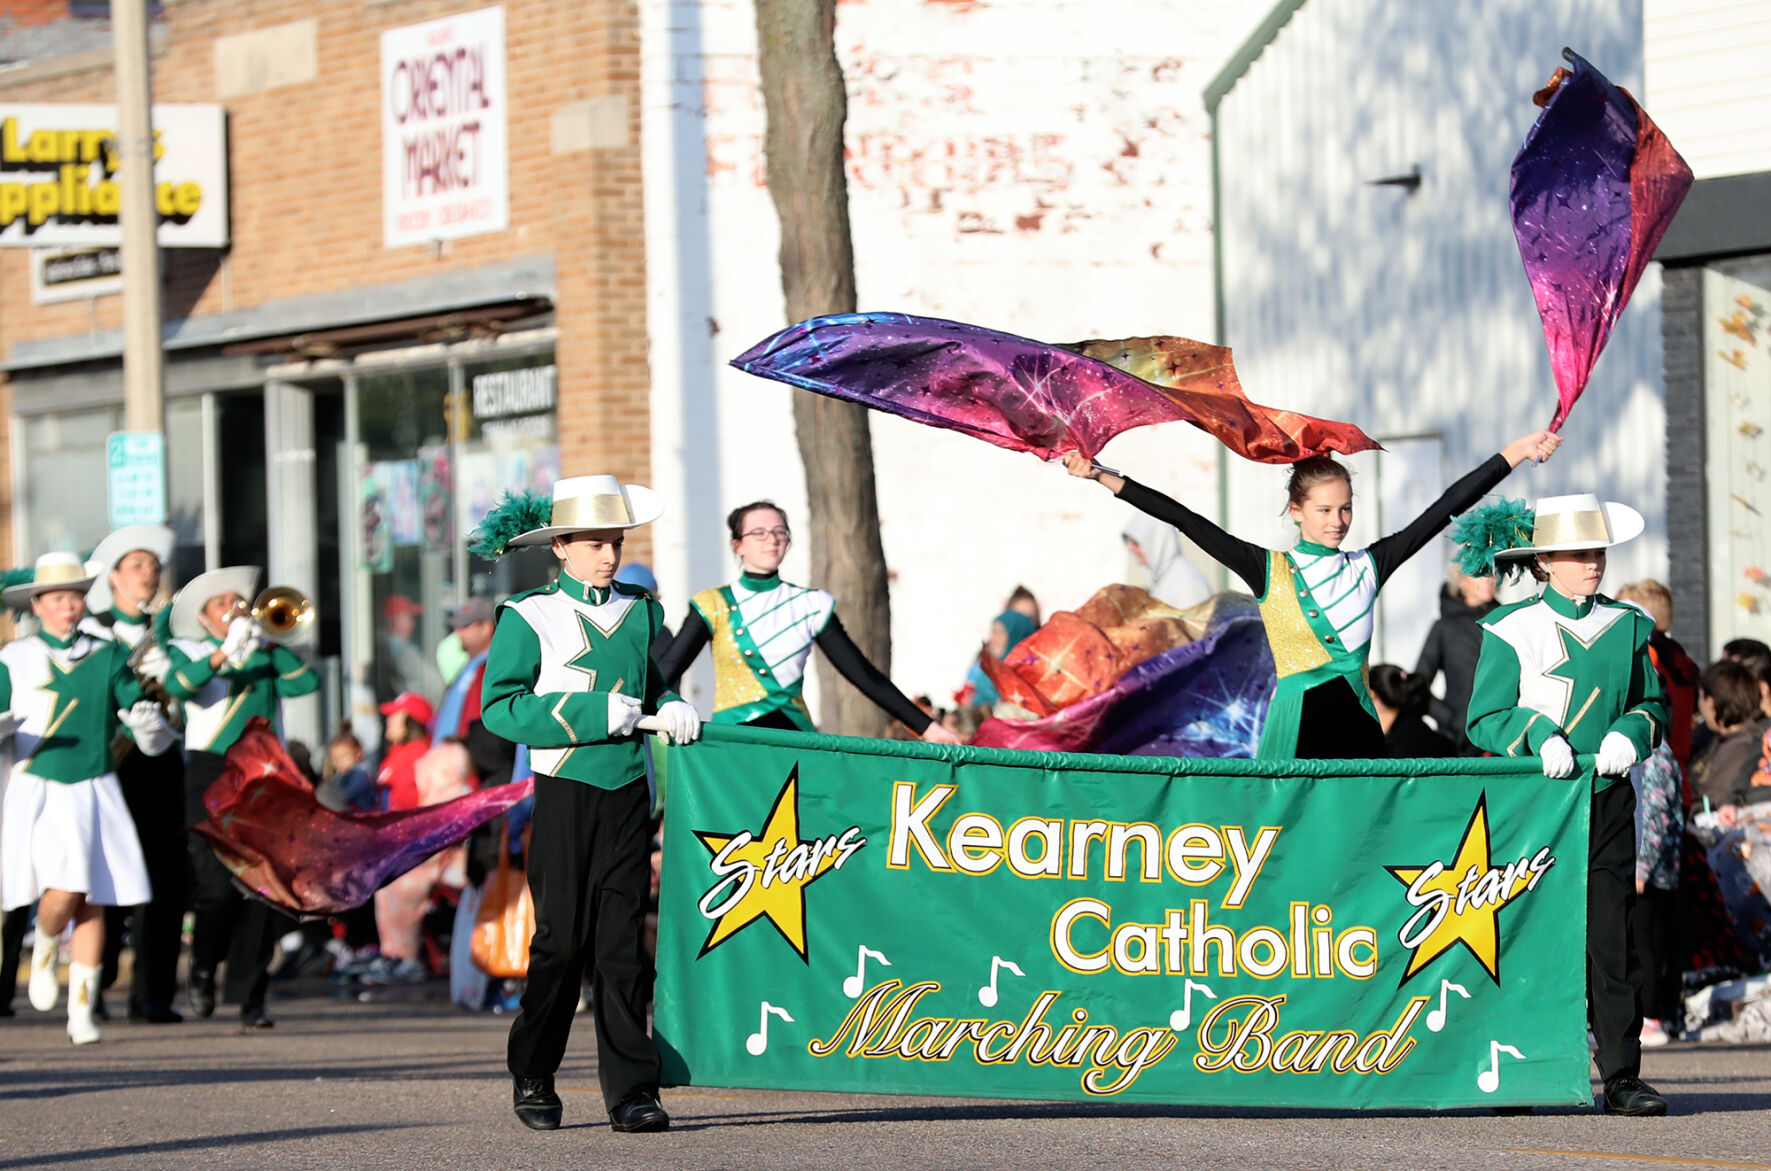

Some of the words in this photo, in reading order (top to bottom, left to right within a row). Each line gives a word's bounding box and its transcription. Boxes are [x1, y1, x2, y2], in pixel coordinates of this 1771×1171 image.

[391, 45, 489, 124] ORIENTAL
[401, 121, 481, 198] MARKET
[472, 365, 557, 418] RESTAURANT
[697, 825, 867, 920] Stars
[886, 780, 1283, 909] Kearney
[1050, 897, 1378, 980] Catholic
[1398, 846, 1556, 950] Stars
[807, 978, 1179, 1096] Marching
[1193, 994, 1431, 1075] Band
